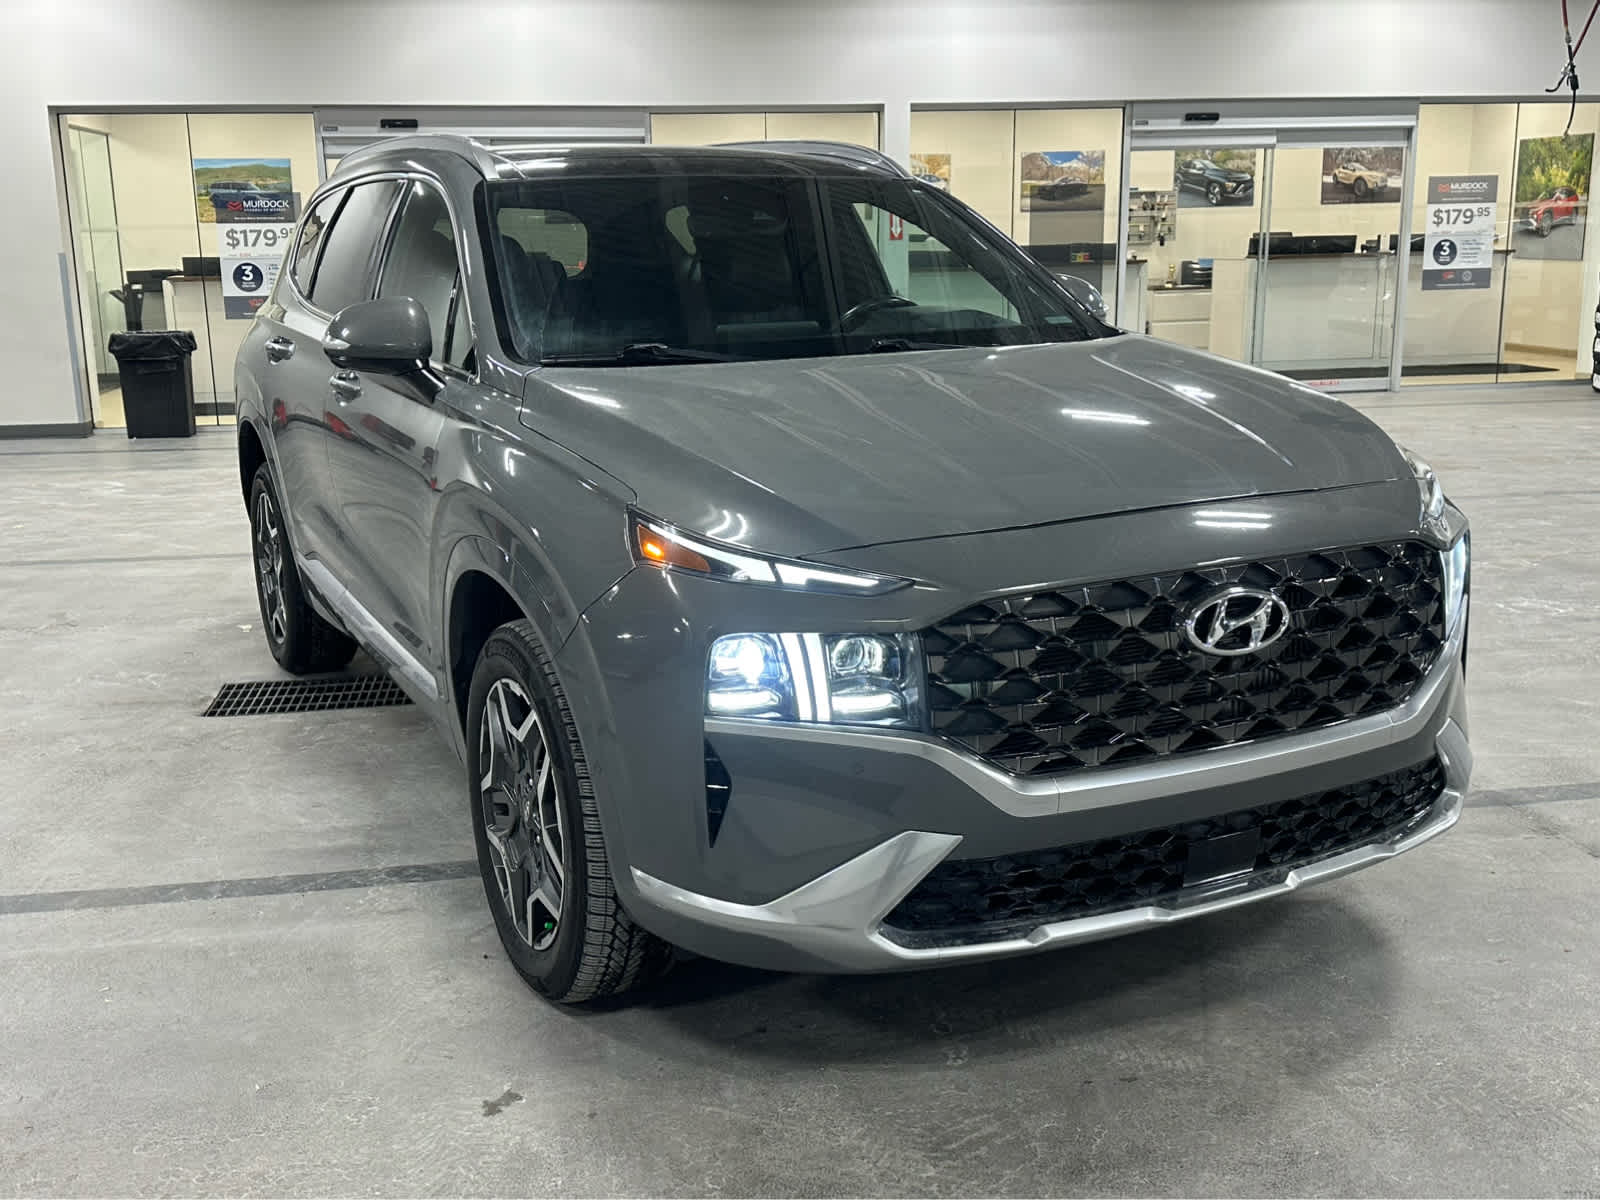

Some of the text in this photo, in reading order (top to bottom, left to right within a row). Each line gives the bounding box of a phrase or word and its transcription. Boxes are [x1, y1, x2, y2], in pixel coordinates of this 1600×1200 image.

[242, 199, 290, 208] MURDOCK
[1440, 241, 1450, 255] 3
[241, 265, 254, 281] 3
